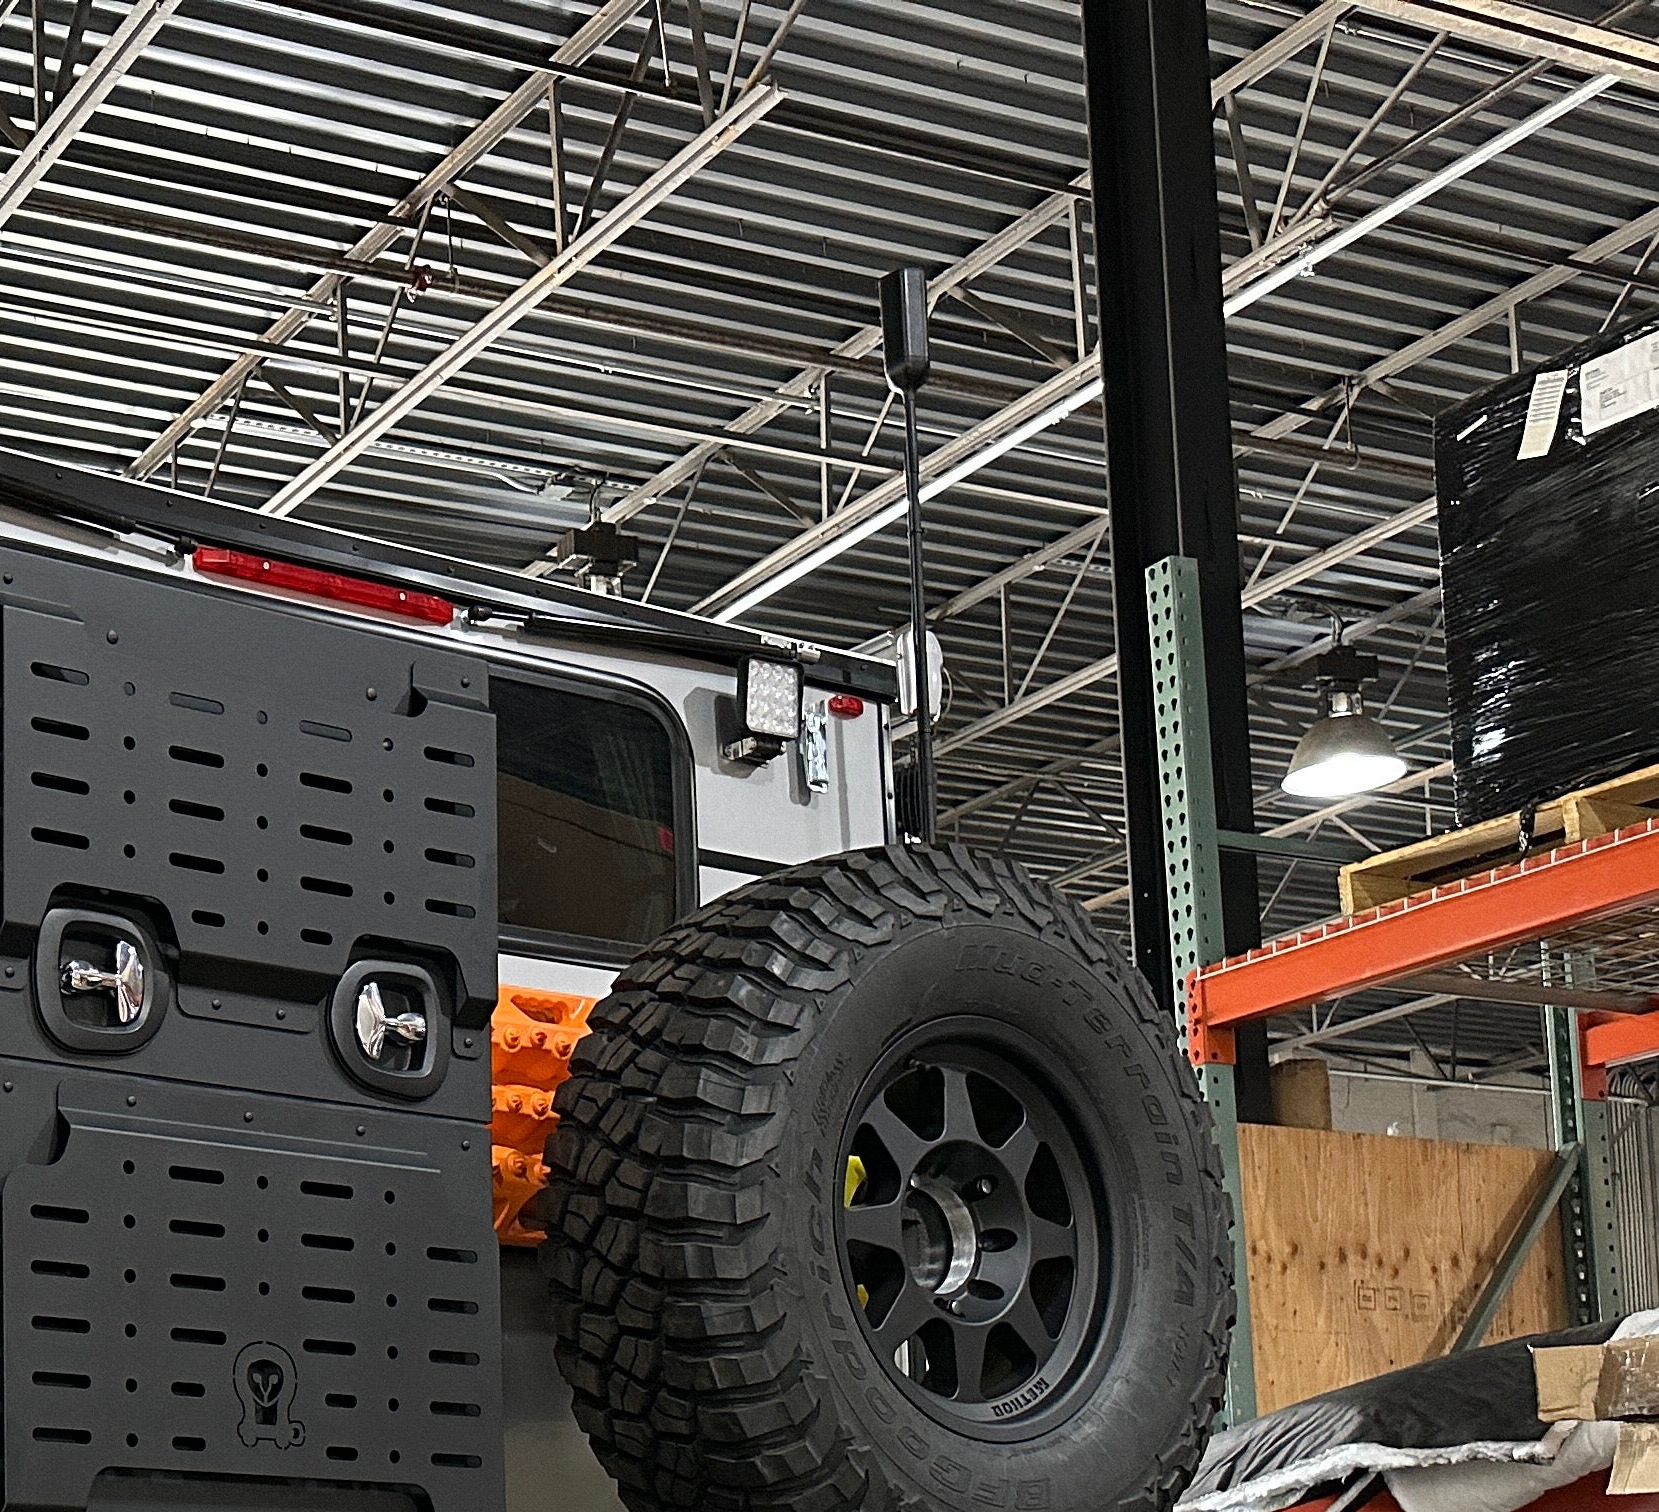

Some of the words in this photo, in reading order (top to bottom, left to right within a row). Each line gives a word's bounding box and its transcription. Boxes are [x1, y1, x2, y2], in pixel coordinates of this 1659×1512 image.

[954, 944, 1184, 1187] Mud-Terrain
[1171, 1202, 1198, 1308] T/A
[803, 1146, 1051, 1511] BFGoodrich
[990, 1377, 1051, 1418] METHOD
